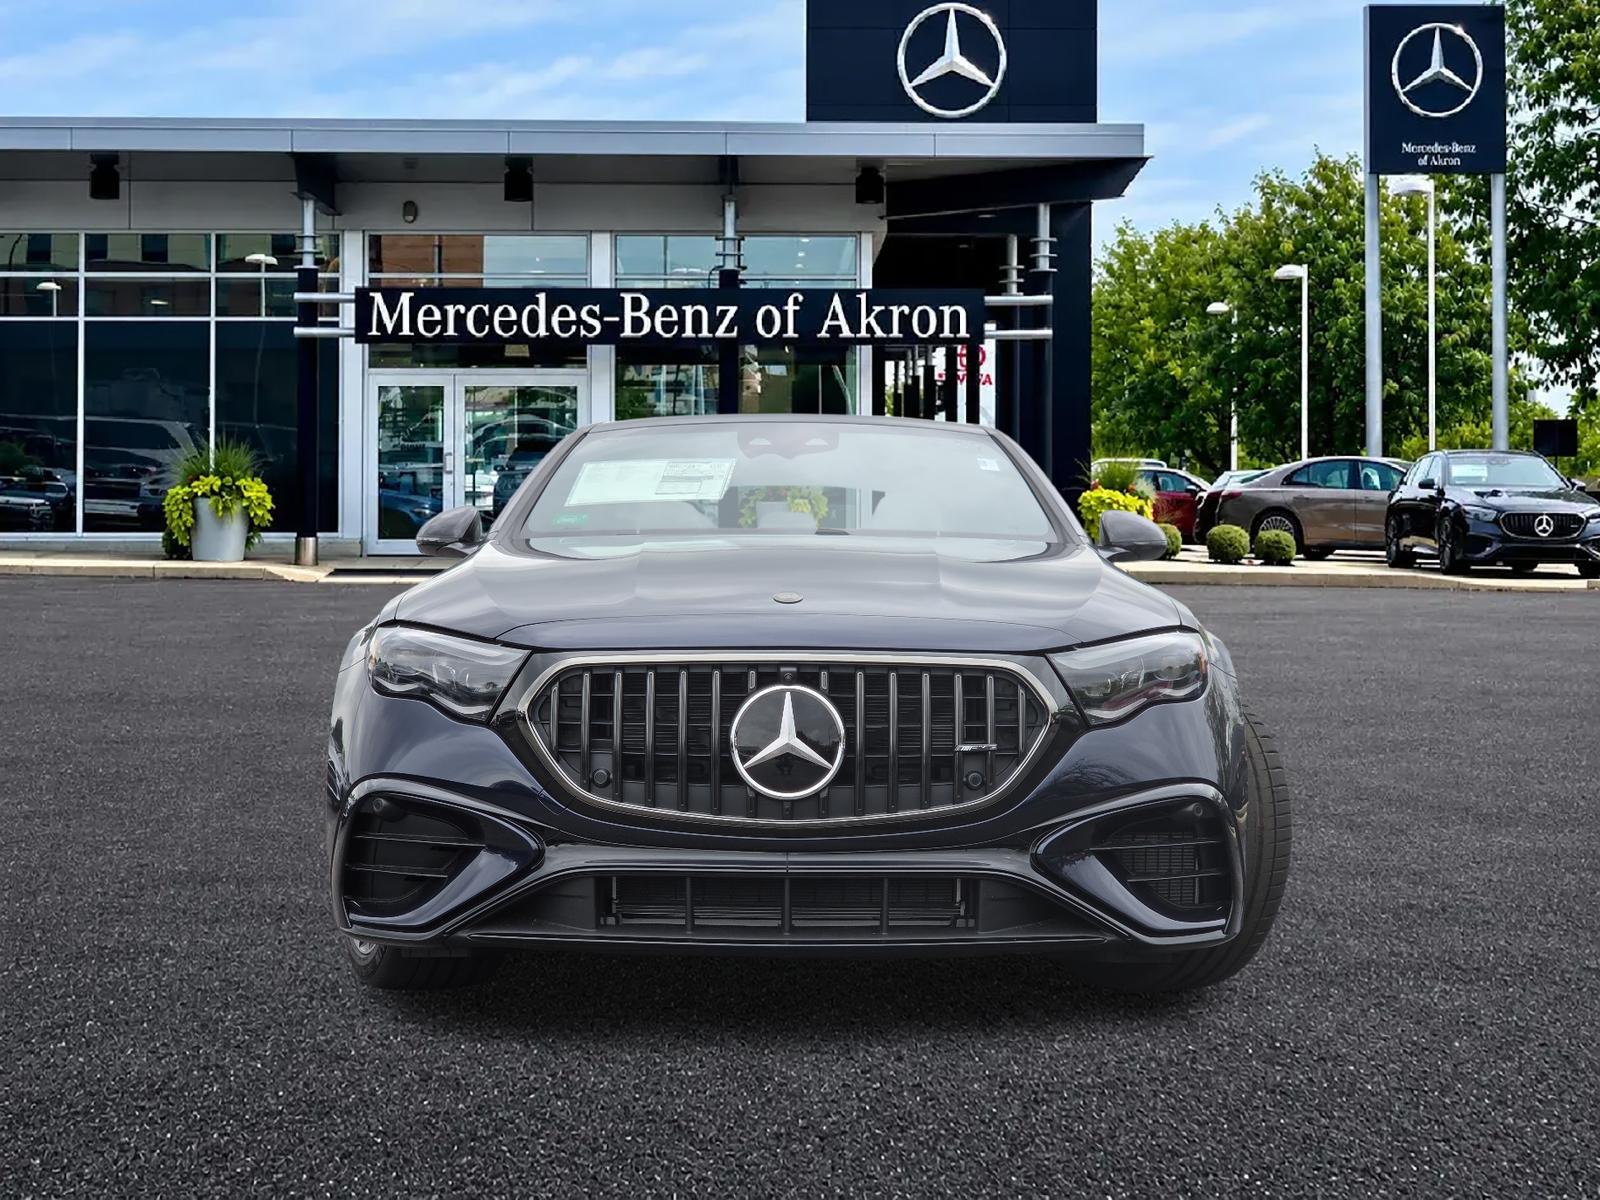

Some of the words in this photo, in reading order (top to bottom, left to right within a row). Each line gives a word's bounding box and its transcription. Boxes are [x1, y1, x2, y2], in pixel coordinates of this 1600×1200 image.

[1401, 141, 1476, 153] Mercedes-Benz
[1418, 154, 1428, 166] of
[1430, 154, 1461, 166] Akron
[367, 291, 738, 338] Mercedes-Benz
[755, 292, 804, 338] of
[816, 291, 971, 338] Akron
